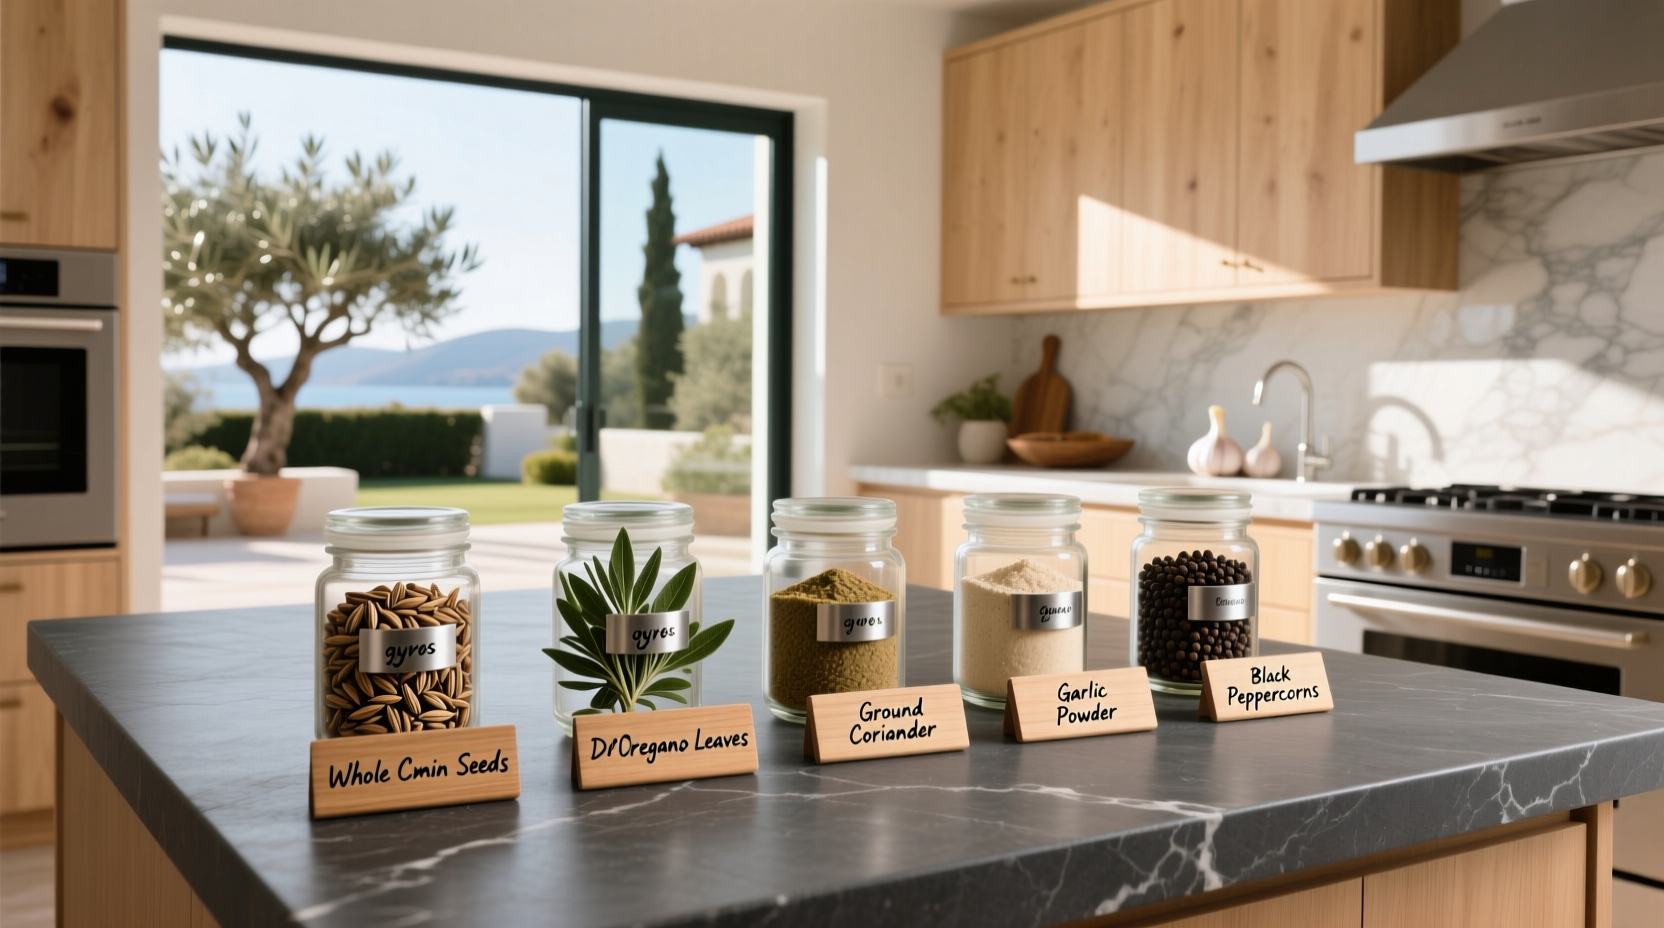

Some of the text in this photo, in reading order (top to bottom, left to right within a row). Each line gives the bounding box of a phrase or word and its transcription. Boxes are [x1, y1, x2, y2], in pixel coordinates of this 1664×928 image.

[385, 642, 436, 668] gyros
[1250, 665, 1291, 685] Black
[1057, 680, 1108, 703] Garlic
[1226, 685, 1319, 711] Peppercorns
[859, 696, 924, 722] Ground
[1056, 702, 1118, 726] Powder
[694, 728, 749, 752] Leaves
[849, 718, 937, 745] Coriander
[329, 748, 509, 789] Whole Cmin Seeds
